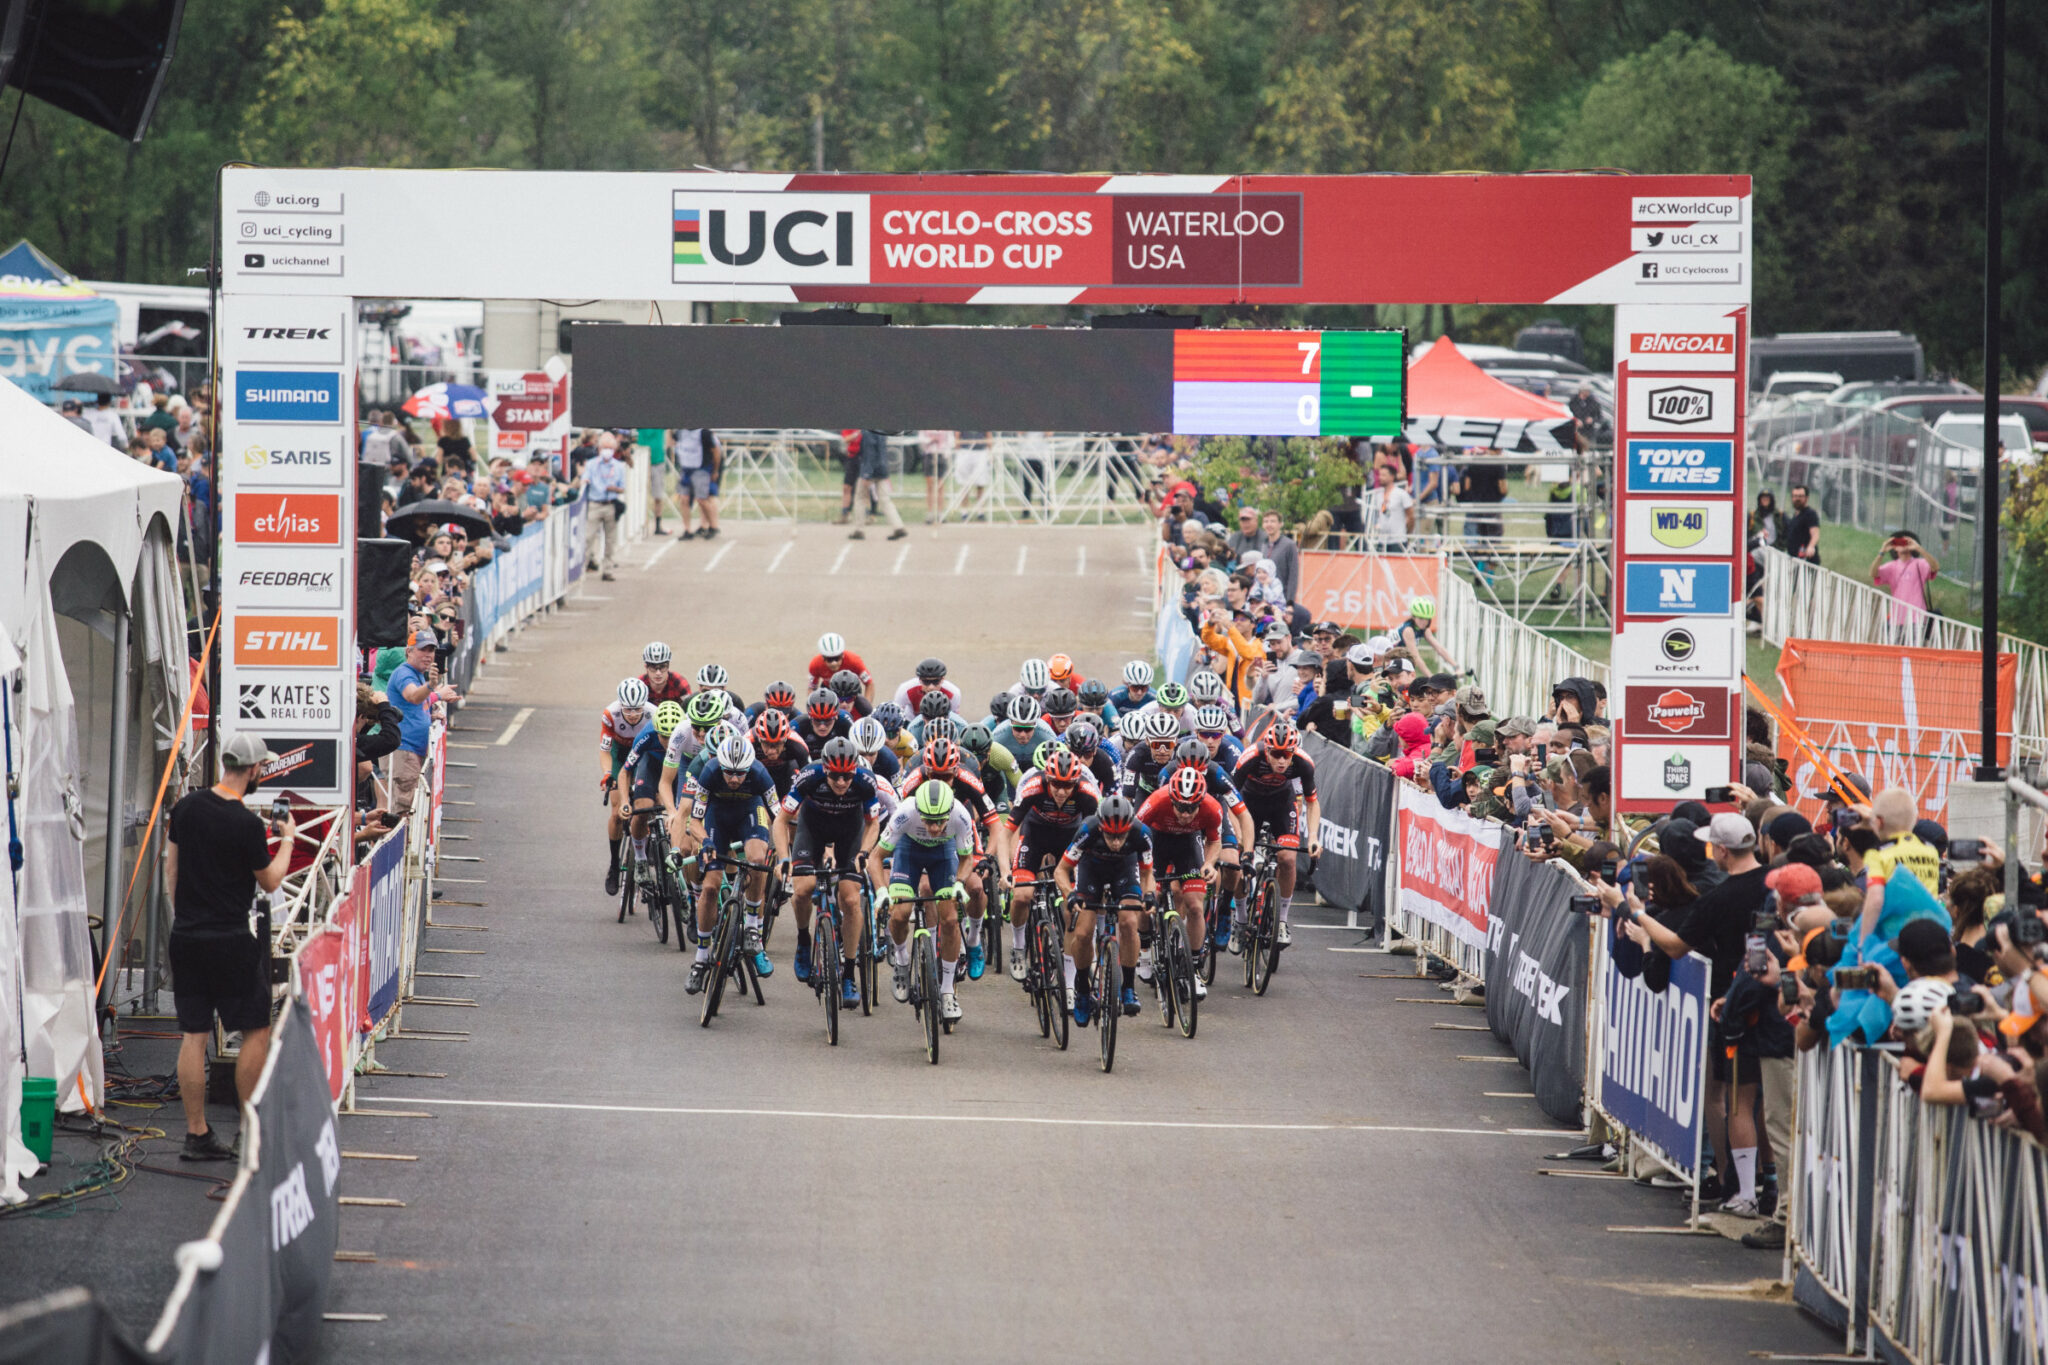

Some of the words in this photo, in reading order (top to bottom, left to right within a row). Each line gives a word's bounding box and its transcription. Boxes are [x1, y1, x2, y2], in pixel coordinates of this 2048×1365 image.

[276, 195, 320, 208] uci.org
[1638, 202, 1733, 218] #CXWorldCup
[882, 210, 1093, 237] CYCLO-CROSS
[1126, 210, 1286, 237] WATERLOO
[263, 225, 332, 240] uci_cycling
[707, 209, 854, 267] UCI
[1671, 234, 1719, 248] UCI_CX
[272, 255, 330, 267] ucichannel
[884, 244, 995, 270] WORLD
[1002, 244, 1063, 270] CUP
[1127, 244, 1186, 271] USA
[1665, 265, 1681, 274] UCI
[1682, 265, 1729, 277] Cyclocross
[243, 327, 332, 340] TREK
[1297, 342, 1320, 375] 7
[502, 382, 524, 392] UCI
[245, 388, 330, 405] SHIMANO
[1297, 394, 1319, 426] 0
[1657, 395, 1704, 416] 100%
[505, 408, 551, 424] START
[1403, 414, 1574, 450] REK
[270, 450, 332, 466] SARIS
[1638, 449, 1705, 466] TOYO
[1648, 467, 1722, 484] TIRES
[254, 497, 320, 539] ethias
[239, 571, 334, 587] FEEDBACK
[1659, 569, 1697, 602] N
[243, 631, 329, 651] STIHL
[271, 685, 331, 705] KATE'S
[271, 707, 298, 719] REAL
[302, 707, 331, 719] FOOD
[1653, 704, 1700, 719] Pauwels
[1666, 766, 1689, 774] THIRD
[1666, 774, 1689, 784] SPACE
[694, 807, 704, 816] 10
